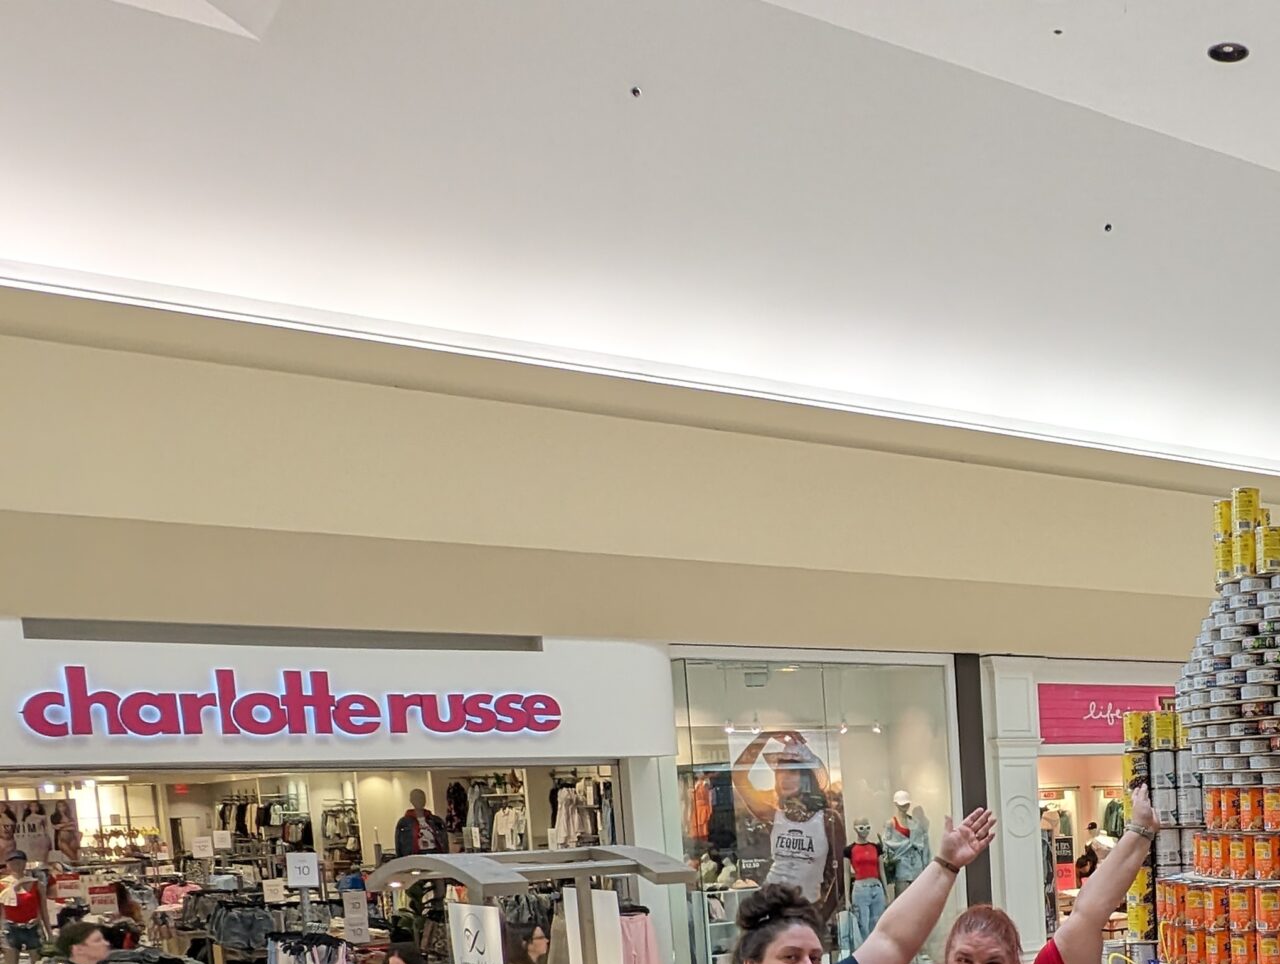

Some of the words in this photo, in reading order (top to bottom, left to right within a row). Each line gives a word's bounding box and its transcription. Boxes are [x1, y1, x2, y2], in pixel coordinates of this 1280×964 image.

[22, 665, 382, 738] charlotte
[388, 692, 562, 734] russe
[775, 836, 814, 852] TEQUILA
